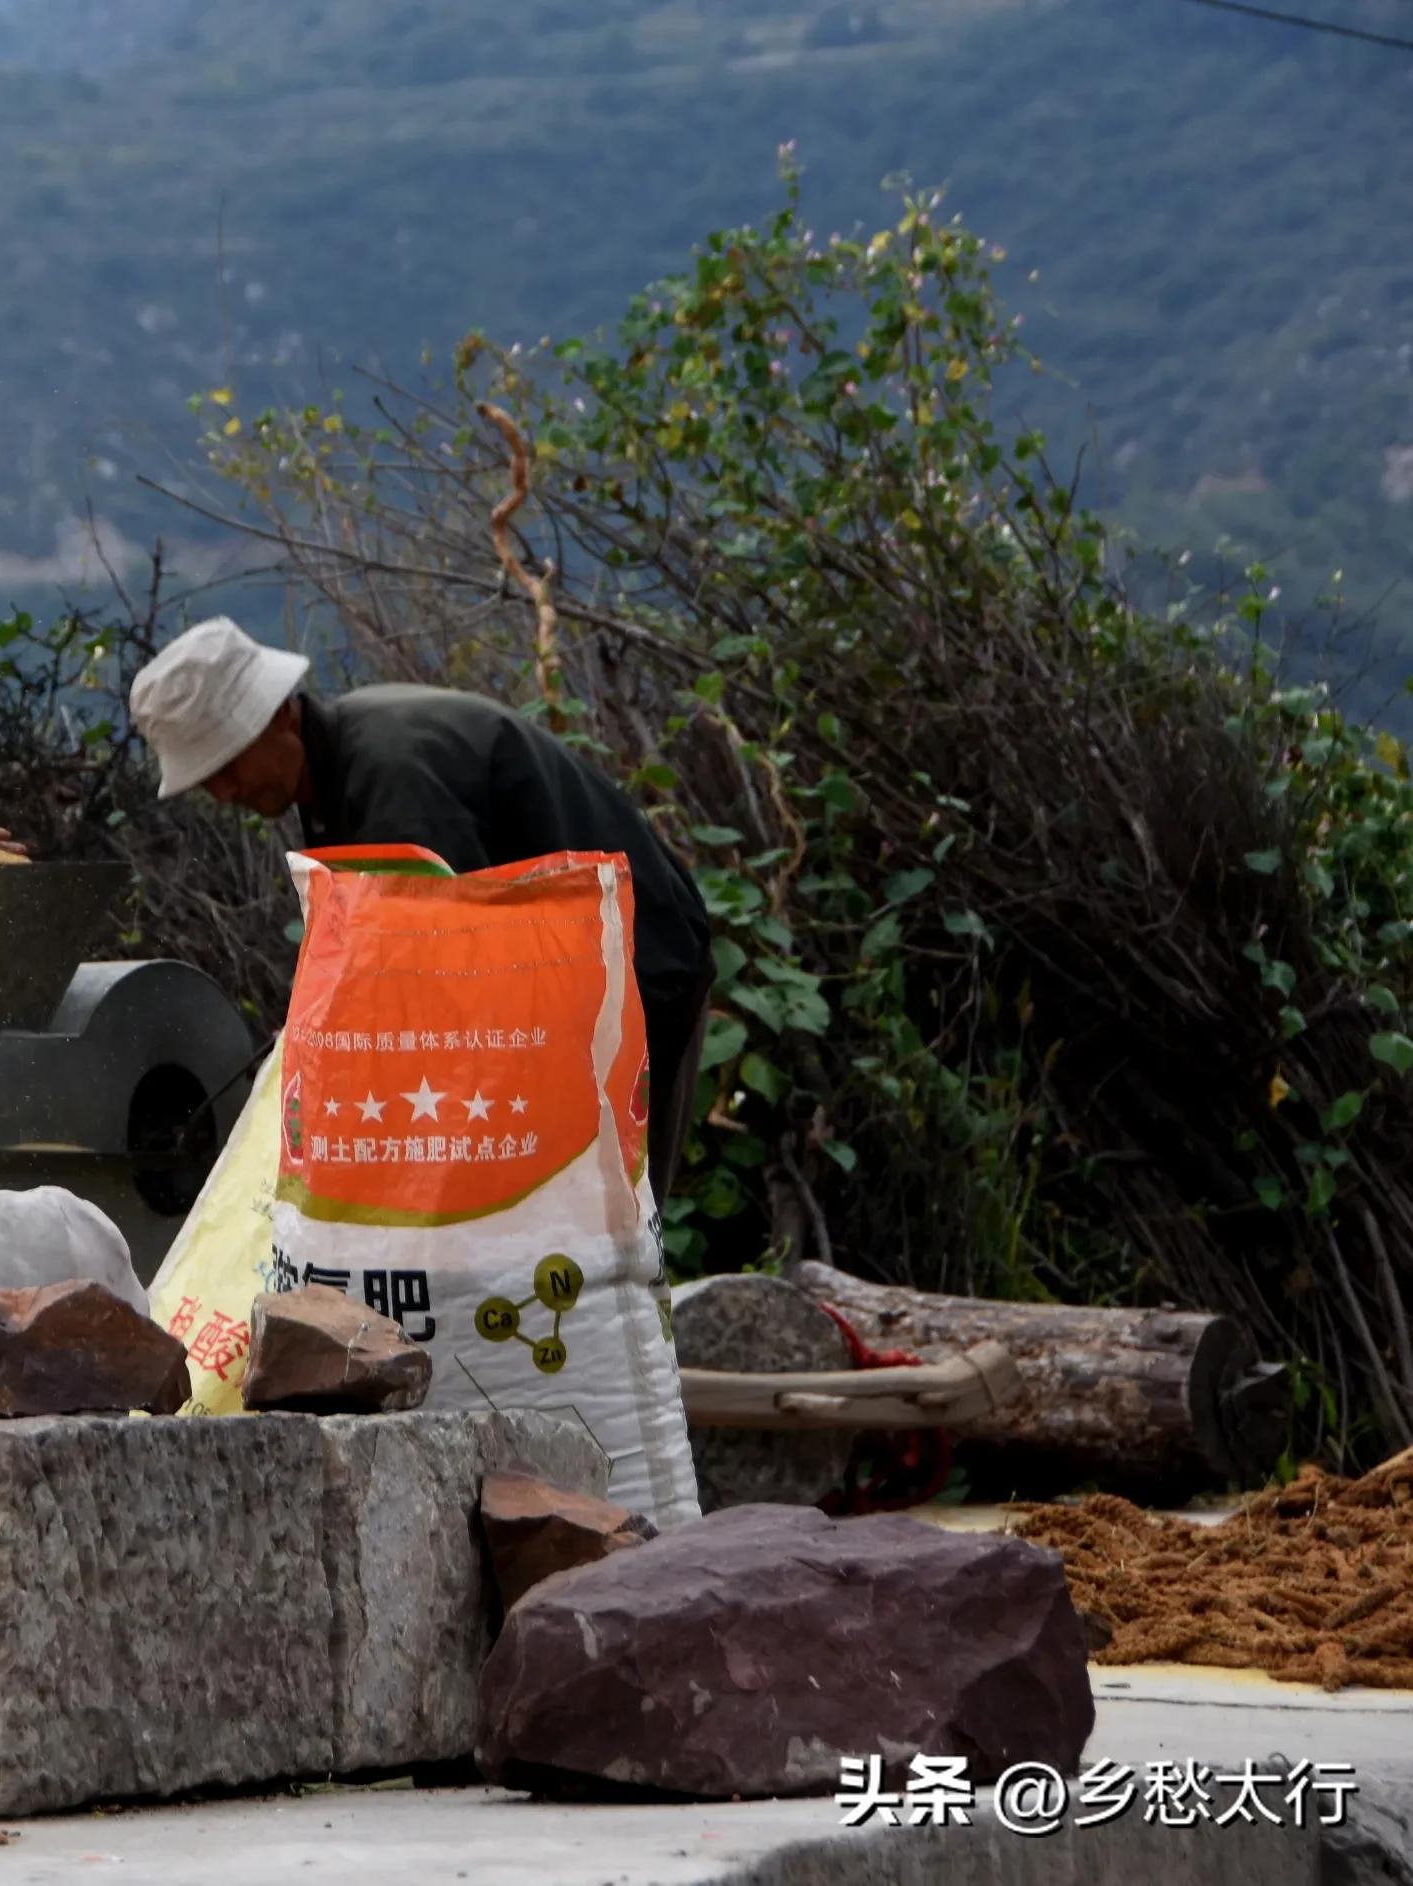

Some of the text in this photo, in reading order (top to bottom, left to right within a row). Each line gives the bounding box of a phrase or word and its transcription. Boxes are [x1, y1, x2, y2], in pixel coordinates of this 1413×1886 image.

[310, 1130, 539, 1163] 测土配方施肥试点企业
[550, 1267, 572, 1297] N
[482, 1308, 513, 1331] Ca
[538, 1347, 562, 1365] Zn
